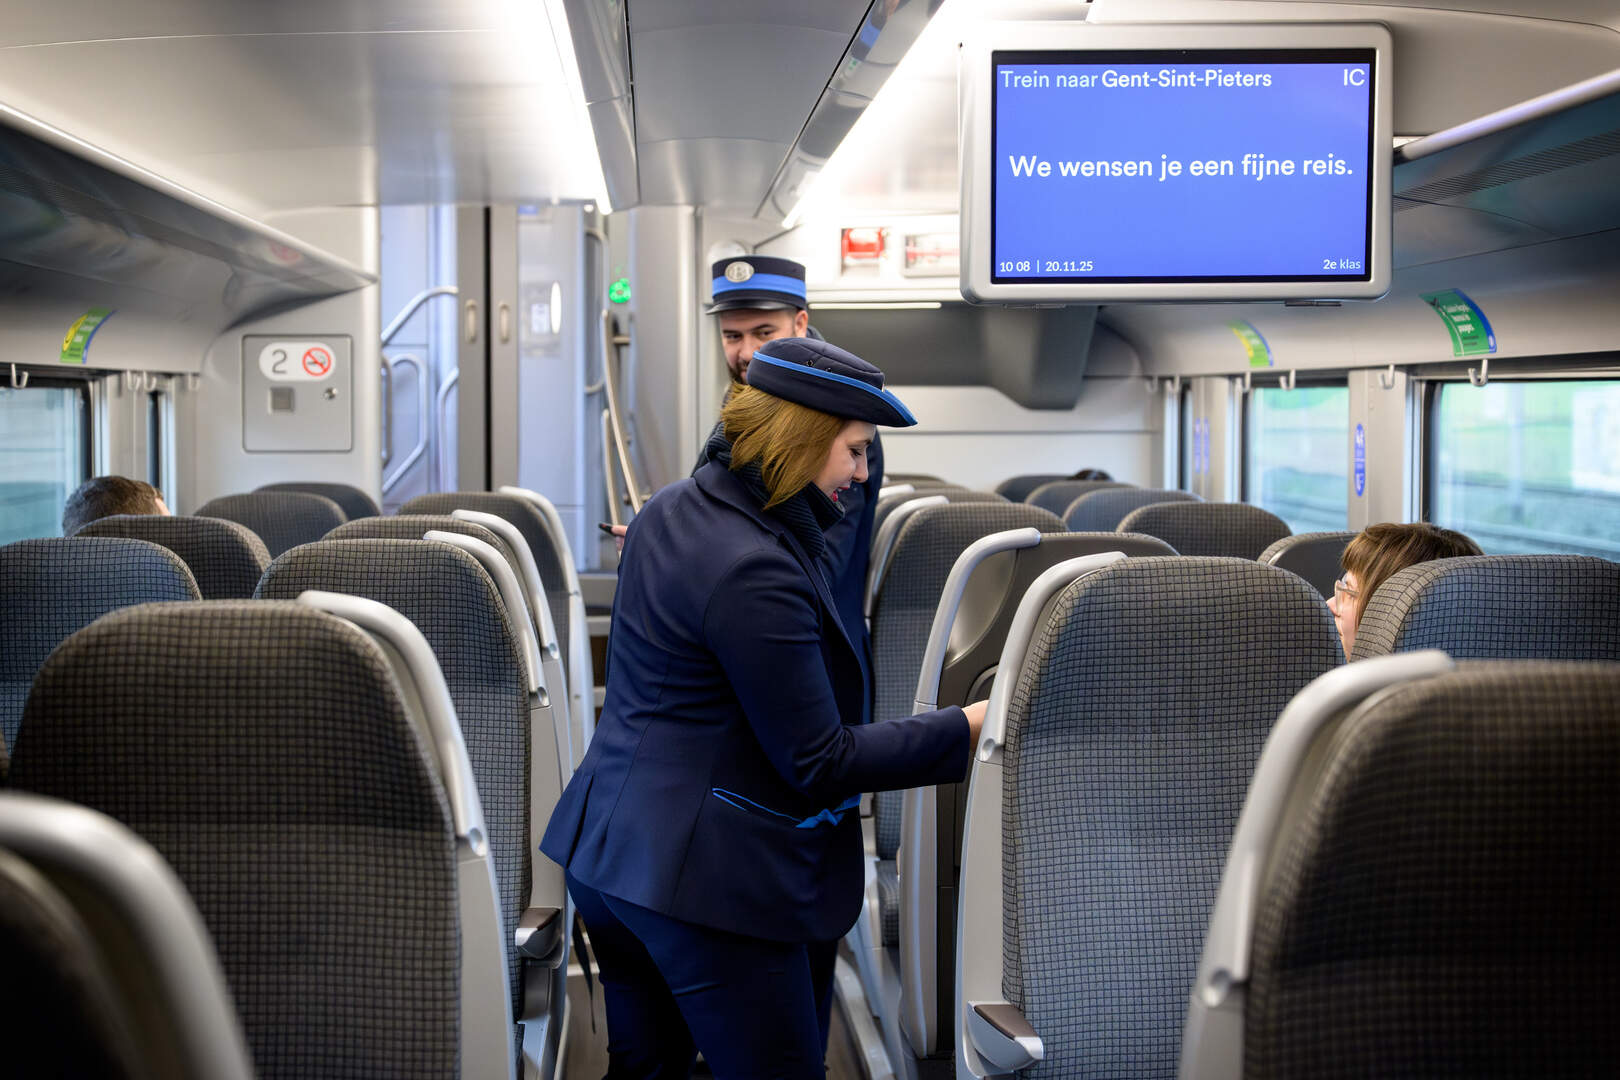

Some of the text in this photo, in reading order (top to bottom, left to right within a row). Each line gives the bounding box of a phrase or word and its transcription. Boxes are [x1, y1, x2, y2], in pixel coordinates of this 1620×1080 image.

[1000, 69, 1273, 88] Trein naar Gent-Sint-Pieters
[1342, 68, 1366, 87] IC
[1009, 152, 1354, 182] We wensen je een fijne reis.
[1045, 260, 1094, 272] 20.11.25
[1323, 257, 1361, 271] 2e klas
[271, 349, 288, 374] 2
